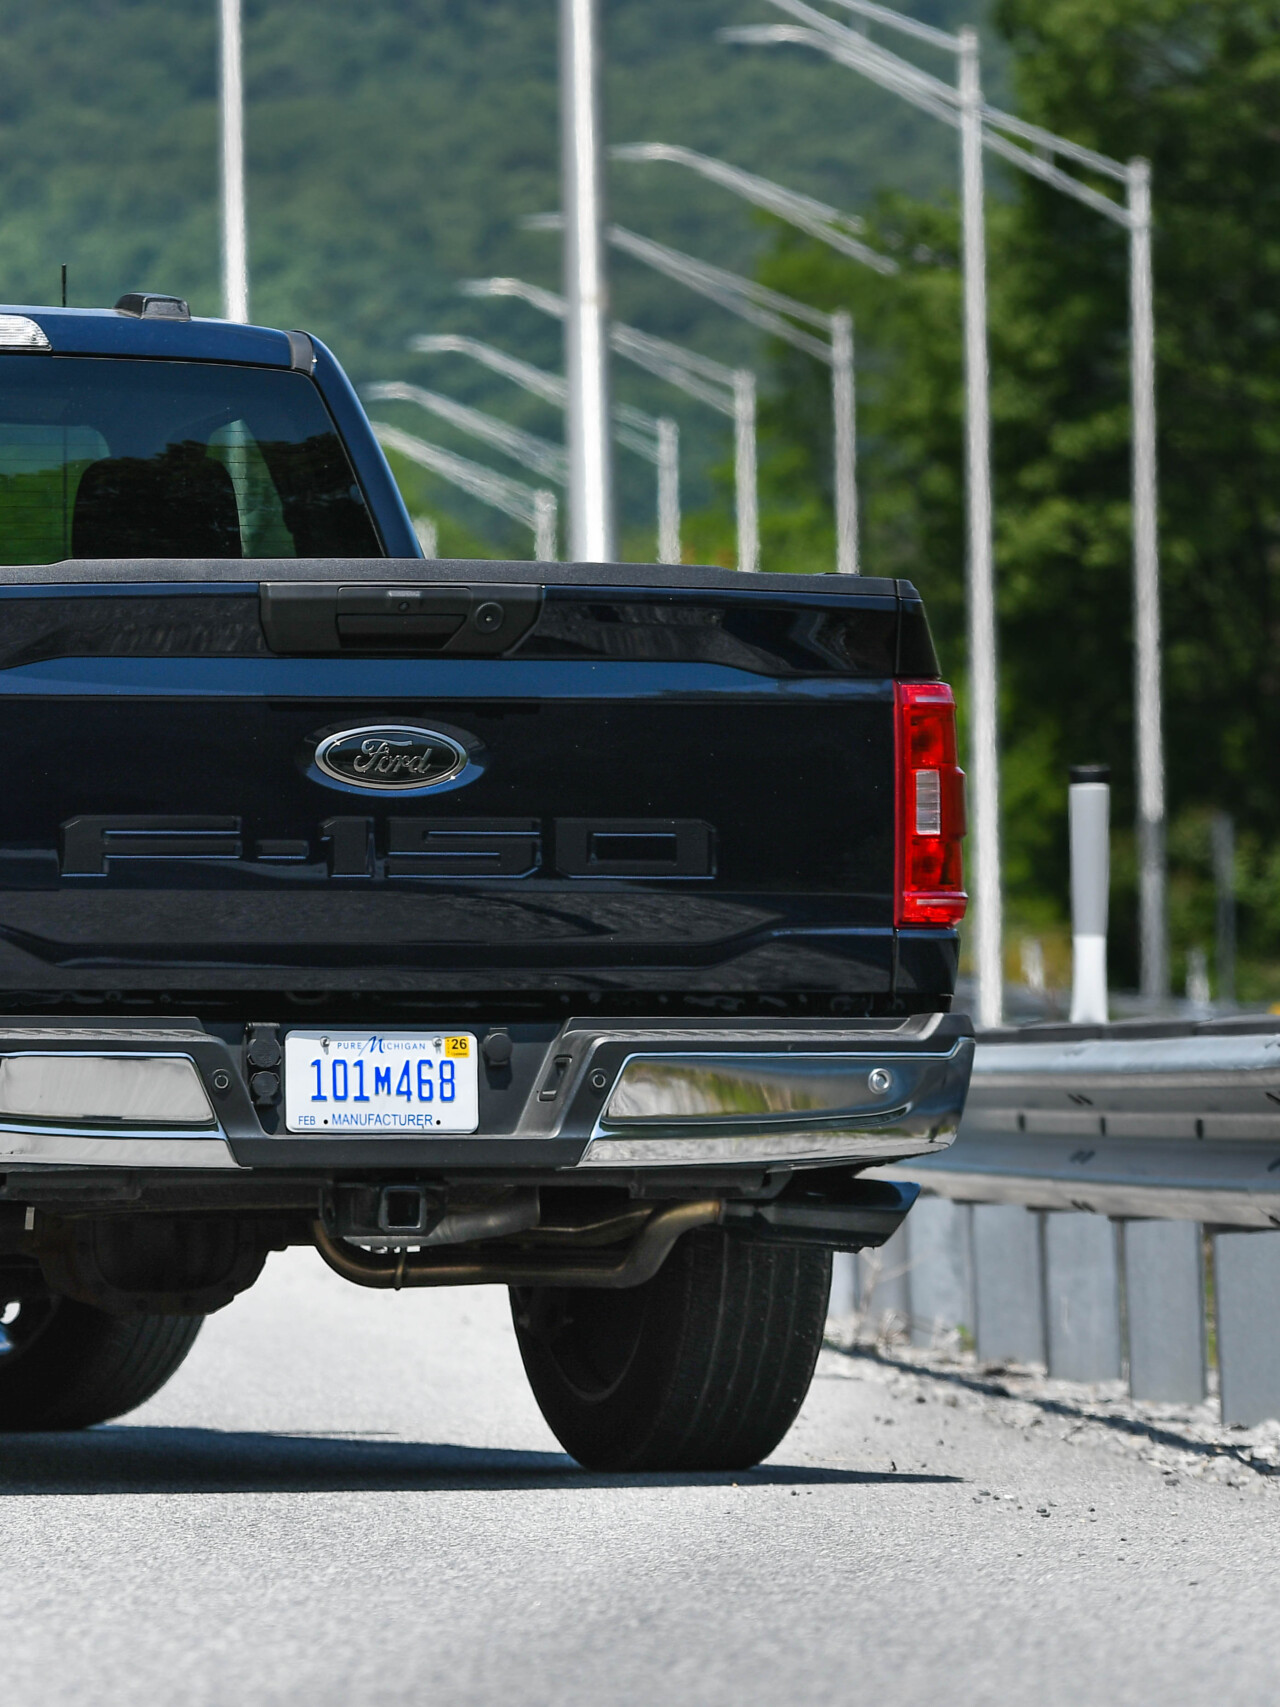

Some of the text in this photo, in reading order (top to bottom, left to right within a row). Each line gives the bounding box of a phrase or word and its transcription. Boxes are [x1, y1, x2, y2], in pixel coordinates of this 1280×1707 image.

[353, 738, 432, 774] Ford
[60, 815, 717, 879] F-150
[337, 1036, 426, 1056] PURE MICHIGAN
[451, 1038, 467, 1050] 26
[311, 1059, 456, 1102] 101M468
[298, 1113, 433, 1126] FEB MANUFACTURER
